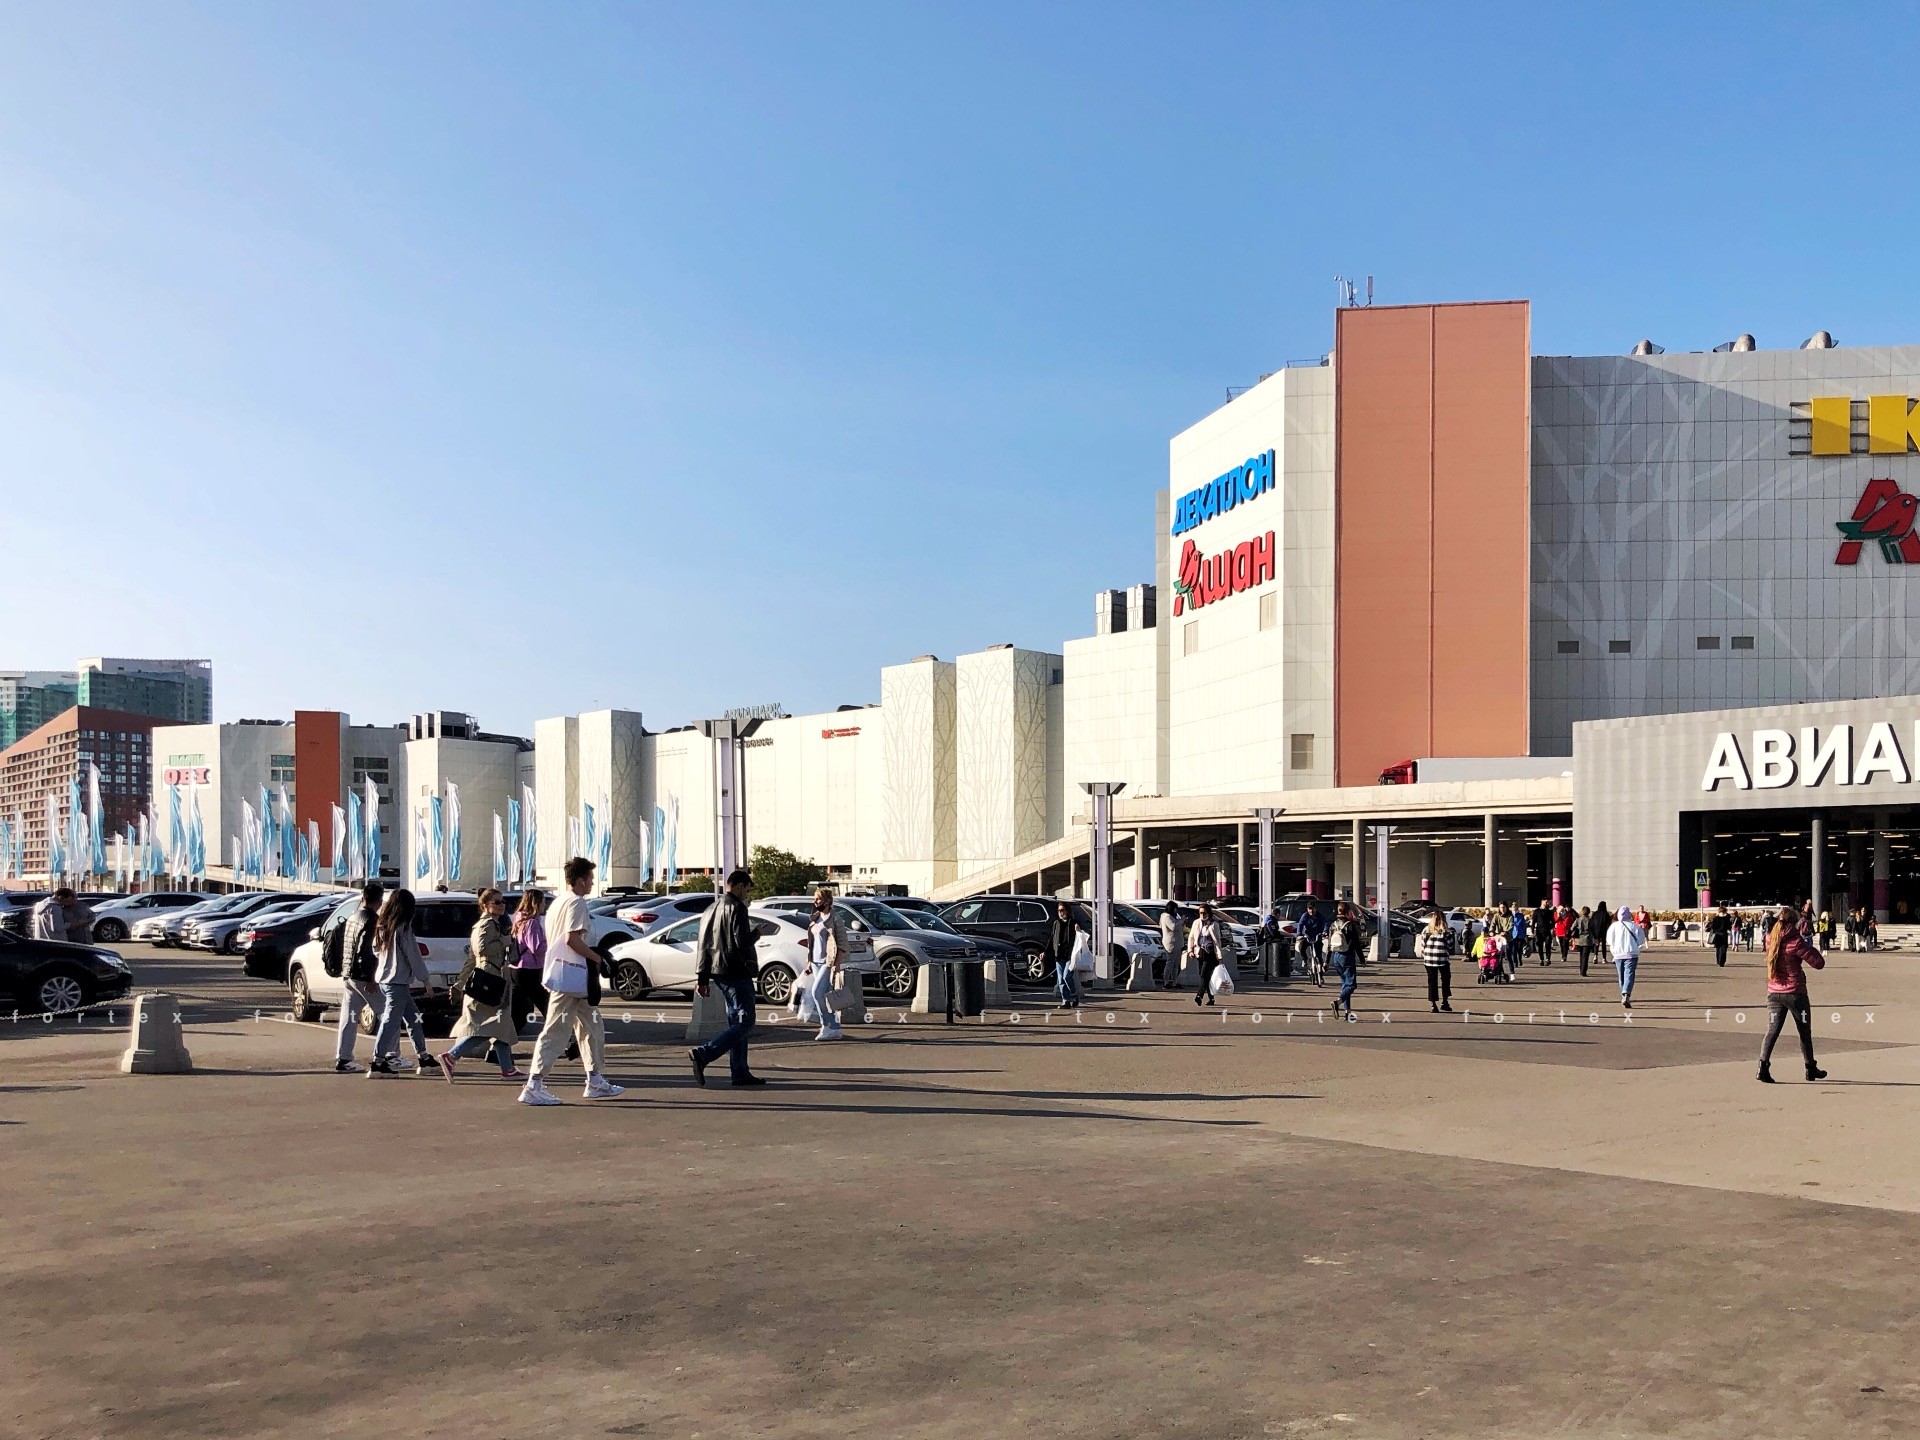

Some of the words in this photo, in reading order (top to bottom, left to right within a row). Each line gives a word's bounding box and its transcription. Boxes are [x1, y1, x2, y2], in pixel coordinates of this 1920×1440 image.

[1171, 448, 1275, 537] ДЕКАТЛОН
[163, 767, 211, 786] OBI
[1701, 720, 1920, 791] АВИА
